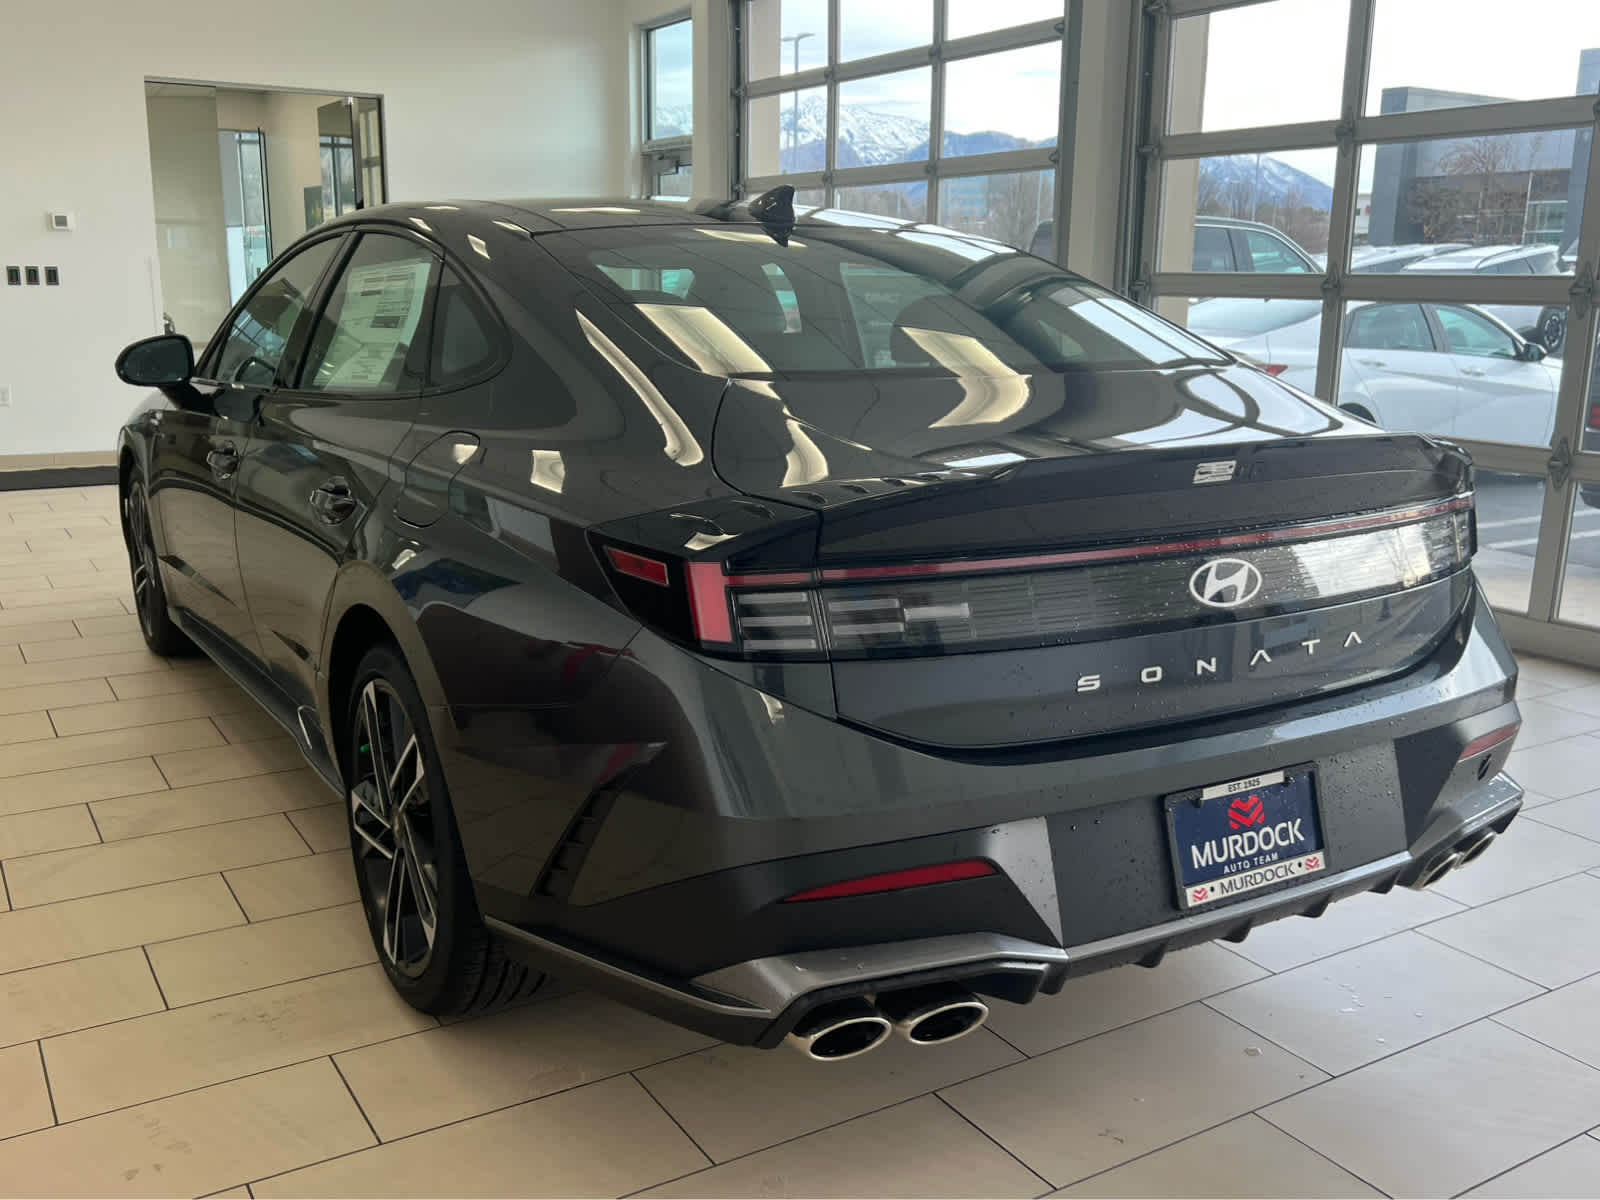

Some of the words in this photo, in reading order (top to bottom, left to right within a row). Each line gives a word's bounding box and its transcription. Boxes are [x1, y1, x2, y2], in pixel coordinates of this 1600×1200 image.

[1077, 631, 1363, 692] SONATA
[1191, 818, 1305, 869] MURDOCK
[1223, 860, 1250, 874] AUTO
[1254, 852, 1279, 866] TEAM
[1220, 862, 1296, 895] MURDOCK
